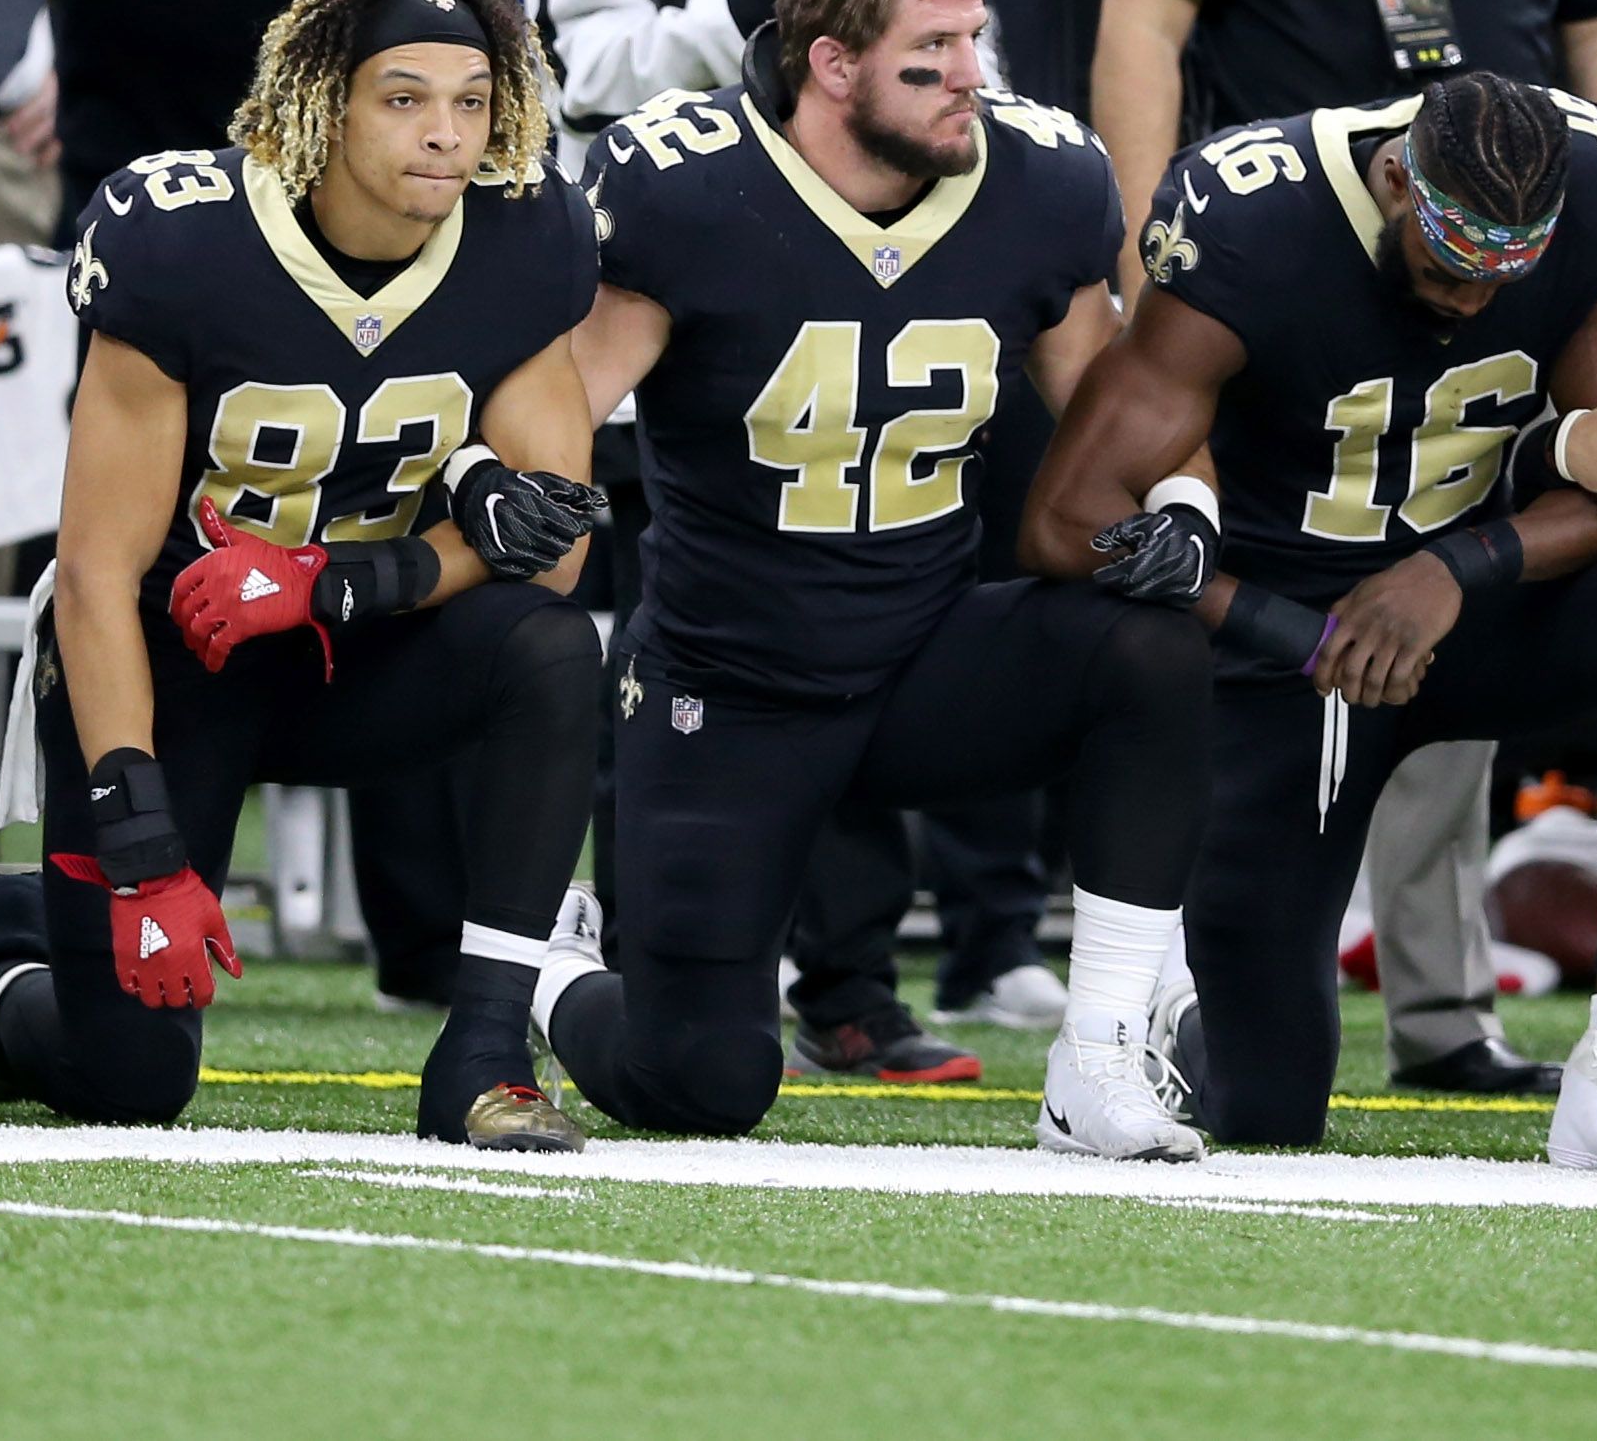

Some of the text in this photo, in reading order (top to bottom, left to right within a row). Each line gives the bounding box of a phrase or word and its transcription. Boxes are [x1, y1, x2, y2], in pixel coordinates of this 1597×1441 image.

[1199, 126, 1308, 196] 16
[877, 258, 898, 274] NFL
[358, 329, 378, 344] NFL
[745, 317, 1001, 535] 42
[1301, 350, 1538, 542] 16
[189, 371, 473, 552] 83
[676, 712, 696, 724] NFL
